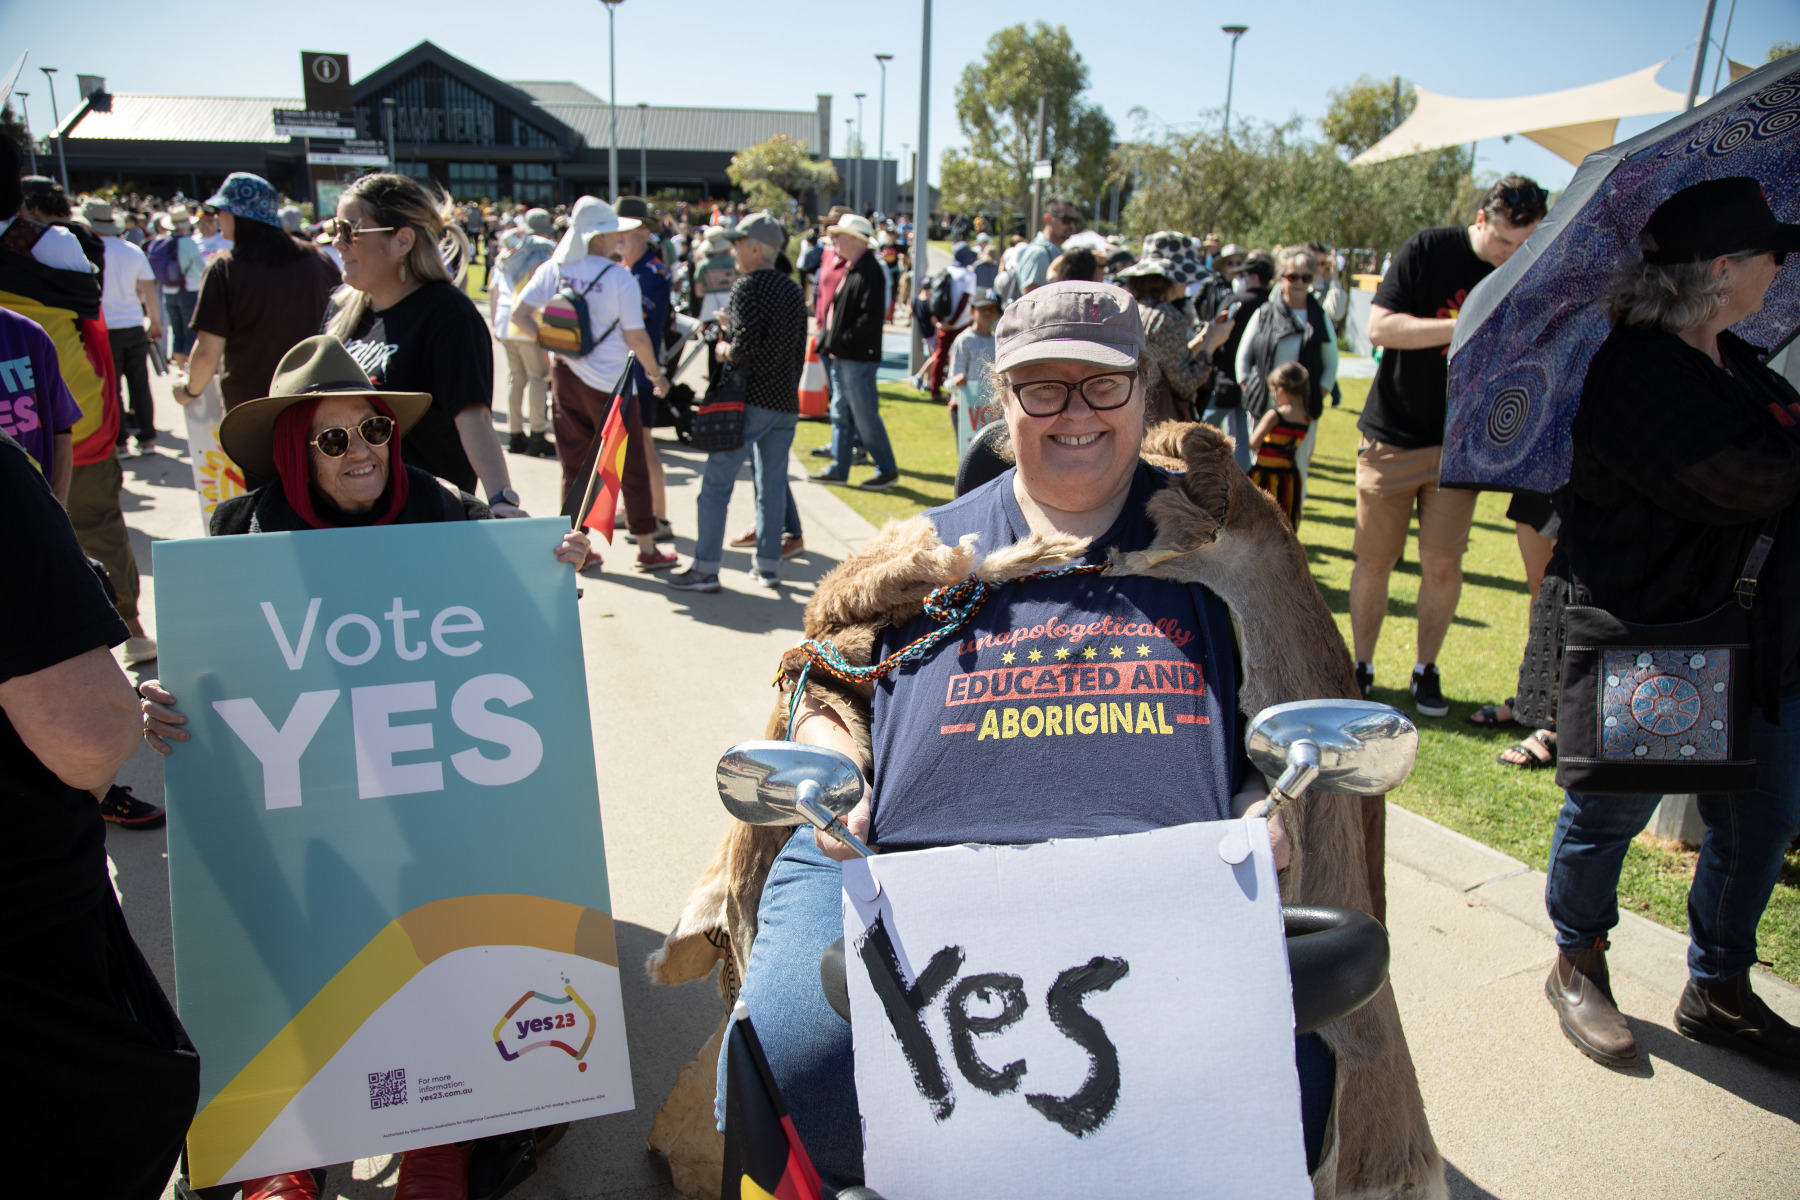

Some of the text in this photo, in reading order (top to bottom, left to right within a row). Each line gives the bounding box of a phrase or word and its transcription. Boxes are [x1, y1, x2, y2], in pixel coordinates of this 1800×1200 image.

[260, 597, 485, 670] Vote
[958, 615, 1195, 655] unapologetically
[950, 664, 1202, 702] EDUCATED AND
[977, 702, 1173, 741] ABORIGINAL
[212, 673, 543, 810] YES
[516, 1013, 576, 1039] yes23
[853, 908, 1130, 1139] Yes
[418, 1081, 465, 1093] information:
[419, 1088, 473, 1103] yes23.com.au
[432, 1075, 451, 1083] more
